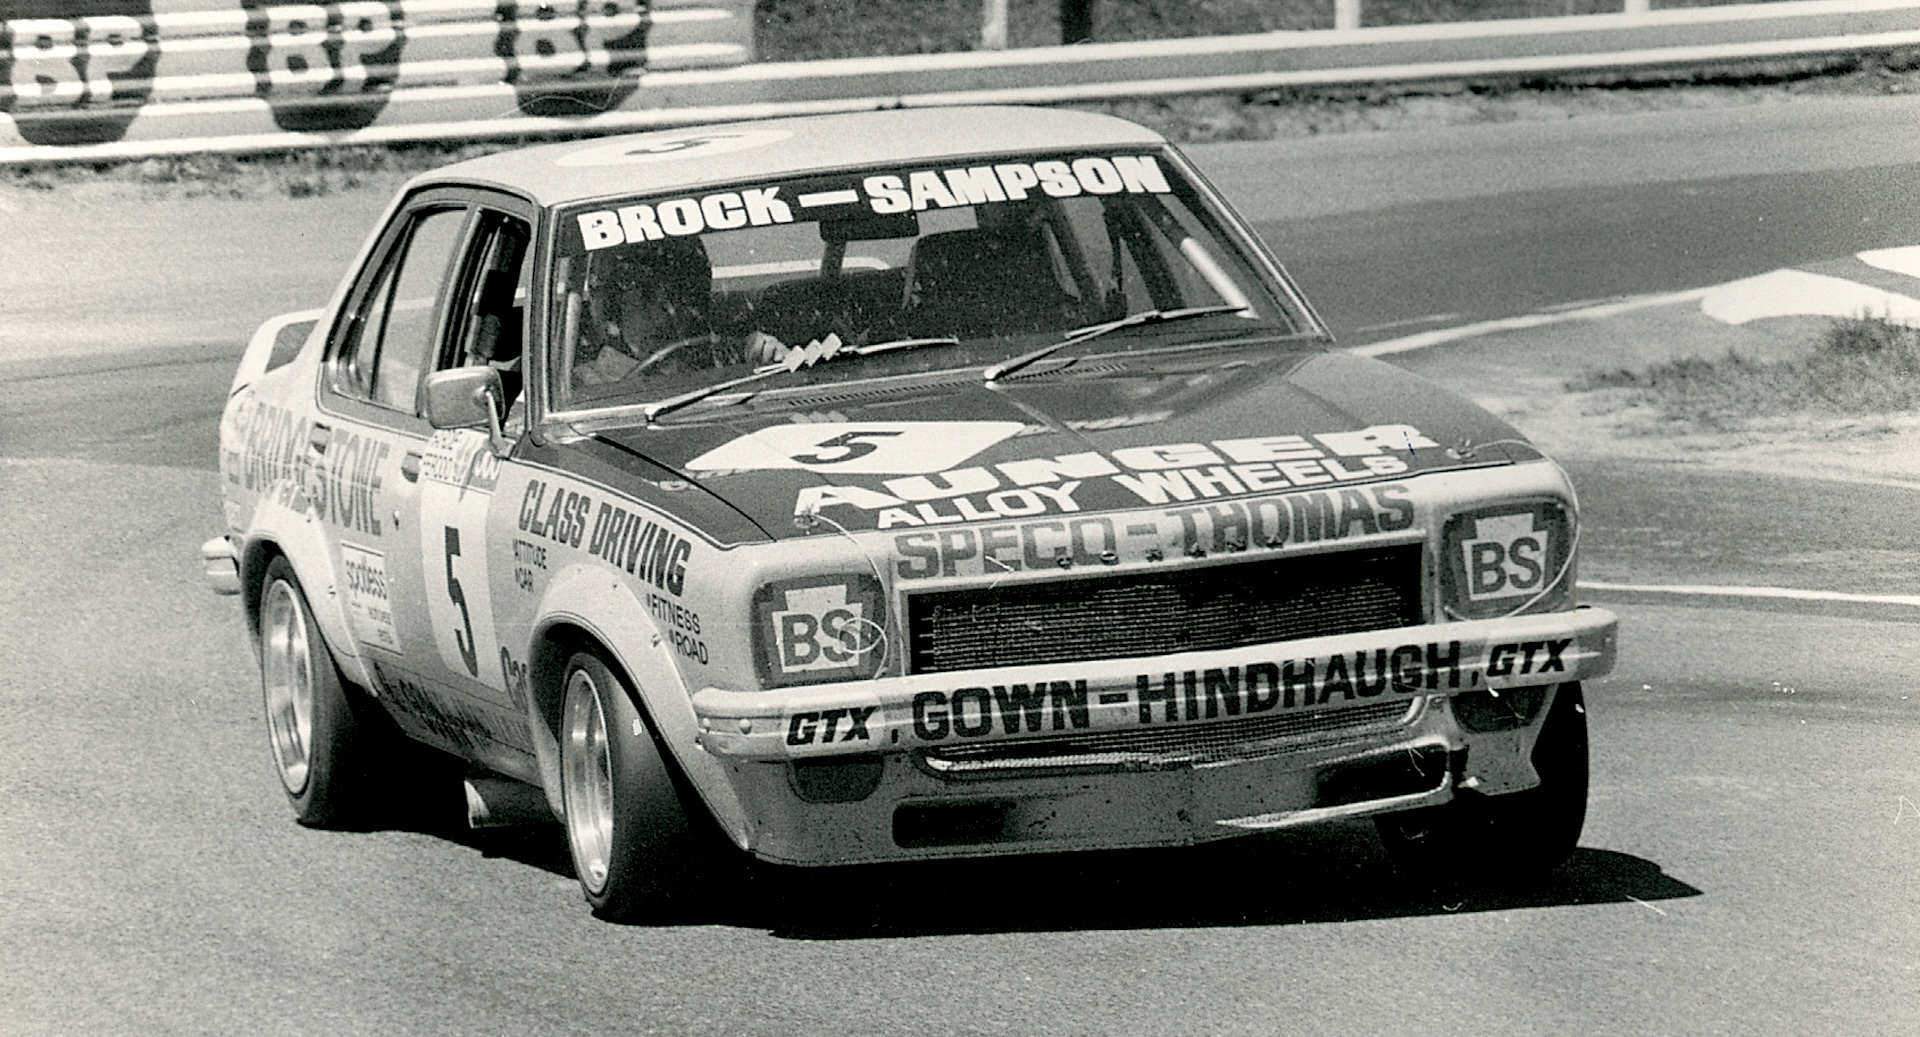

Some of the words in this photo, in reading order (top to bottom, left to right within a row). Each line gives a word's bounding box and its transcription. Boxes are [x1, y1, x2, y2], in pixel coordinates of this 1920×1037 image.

[11, 18, 148, 106] BP
[266, 4, 397, 96] BP
[514, 0, 642, 77] BP
[577, 187, 794, 250] BROCK
[863, 156, 1172, 214] SAMPSON
[790, 430, 905, 464] 5
[794, 424, 1440, 518] AUNGER
[878, 480, 1082, 529] ALLOY
[1111, 455, 1408, 505] WHEELS
[1165, 484, 1414, 557] THOMAS
[518, 479, 591, 549] CLASS
[588, 501, 692, 597] DRIVING
[1471, 536, 1543, 594] BS
[445, 525, 479, 678] 5
[652, 593, 700, 635] FITNESS
[781, 608, 859, 666] BS
[675, 631, 709, 665] ROAD
[1486, 638, 1573, 677] GTX
[786, 705, 879, 746] GTX
[911, 680, 1091, 741] GOWN
[1136, 640, 1461, 724] HINDHAUGH
